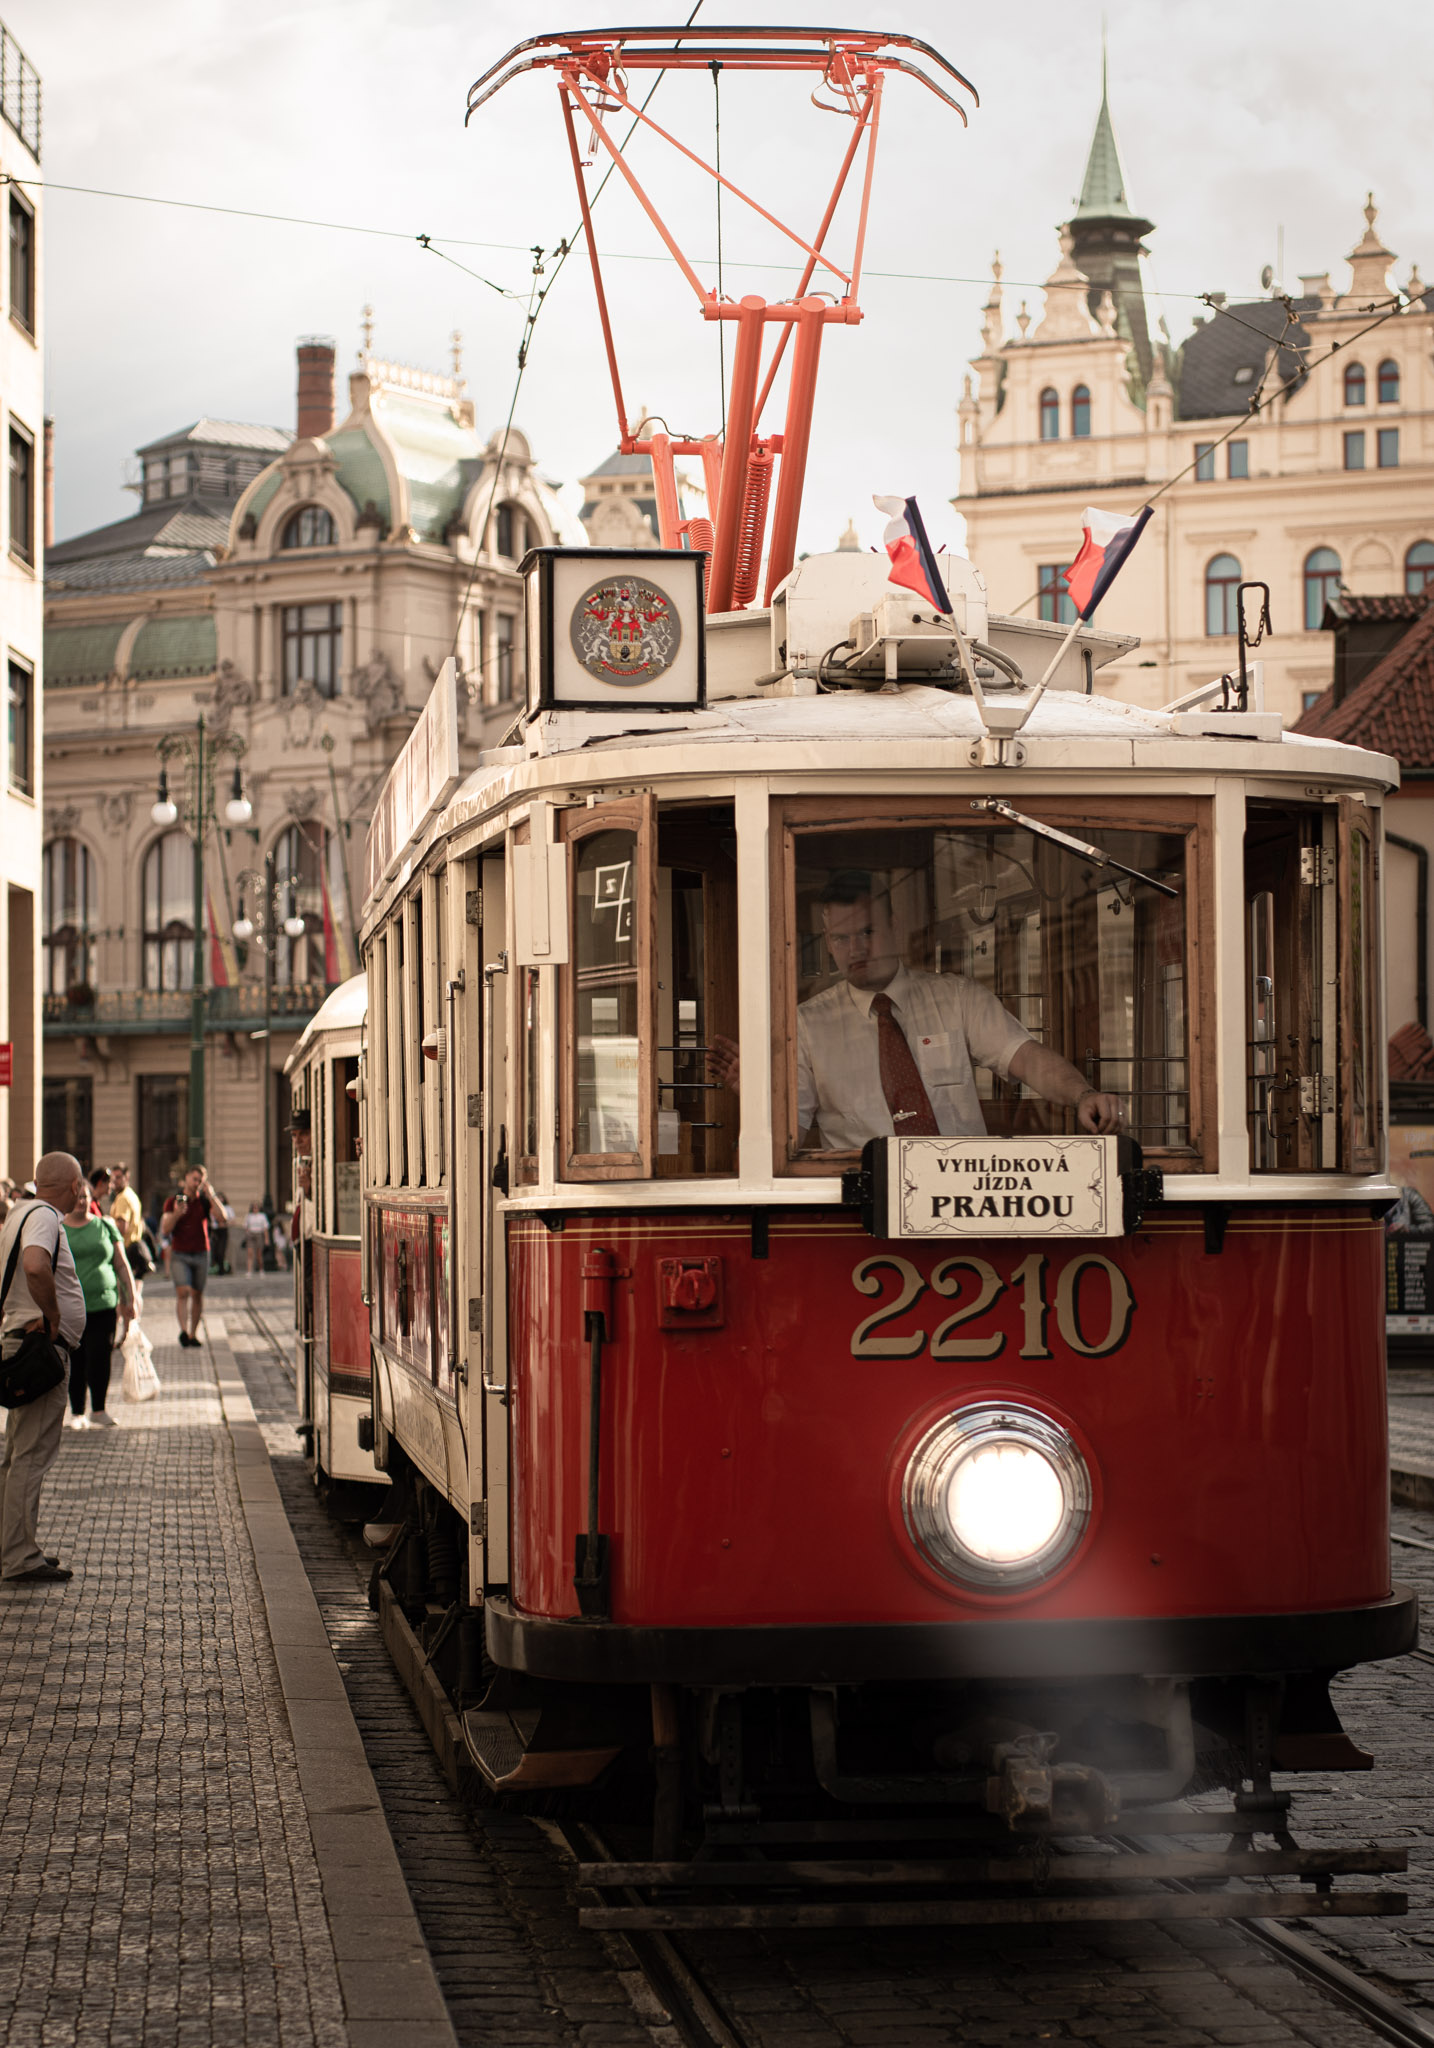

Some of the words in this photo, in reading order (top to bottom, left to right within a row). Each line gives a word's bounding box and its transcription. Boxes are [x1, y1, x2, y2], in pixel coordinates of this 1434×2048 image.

[937, 1155, 1069, 1172] VYHLÍDKOVÁ
[973, 1173, 1032, 1190] JÍZDA
[931, 1195, 1073, 1217] PRAHOU
[851, 1254, 1137, 1361] 2210
